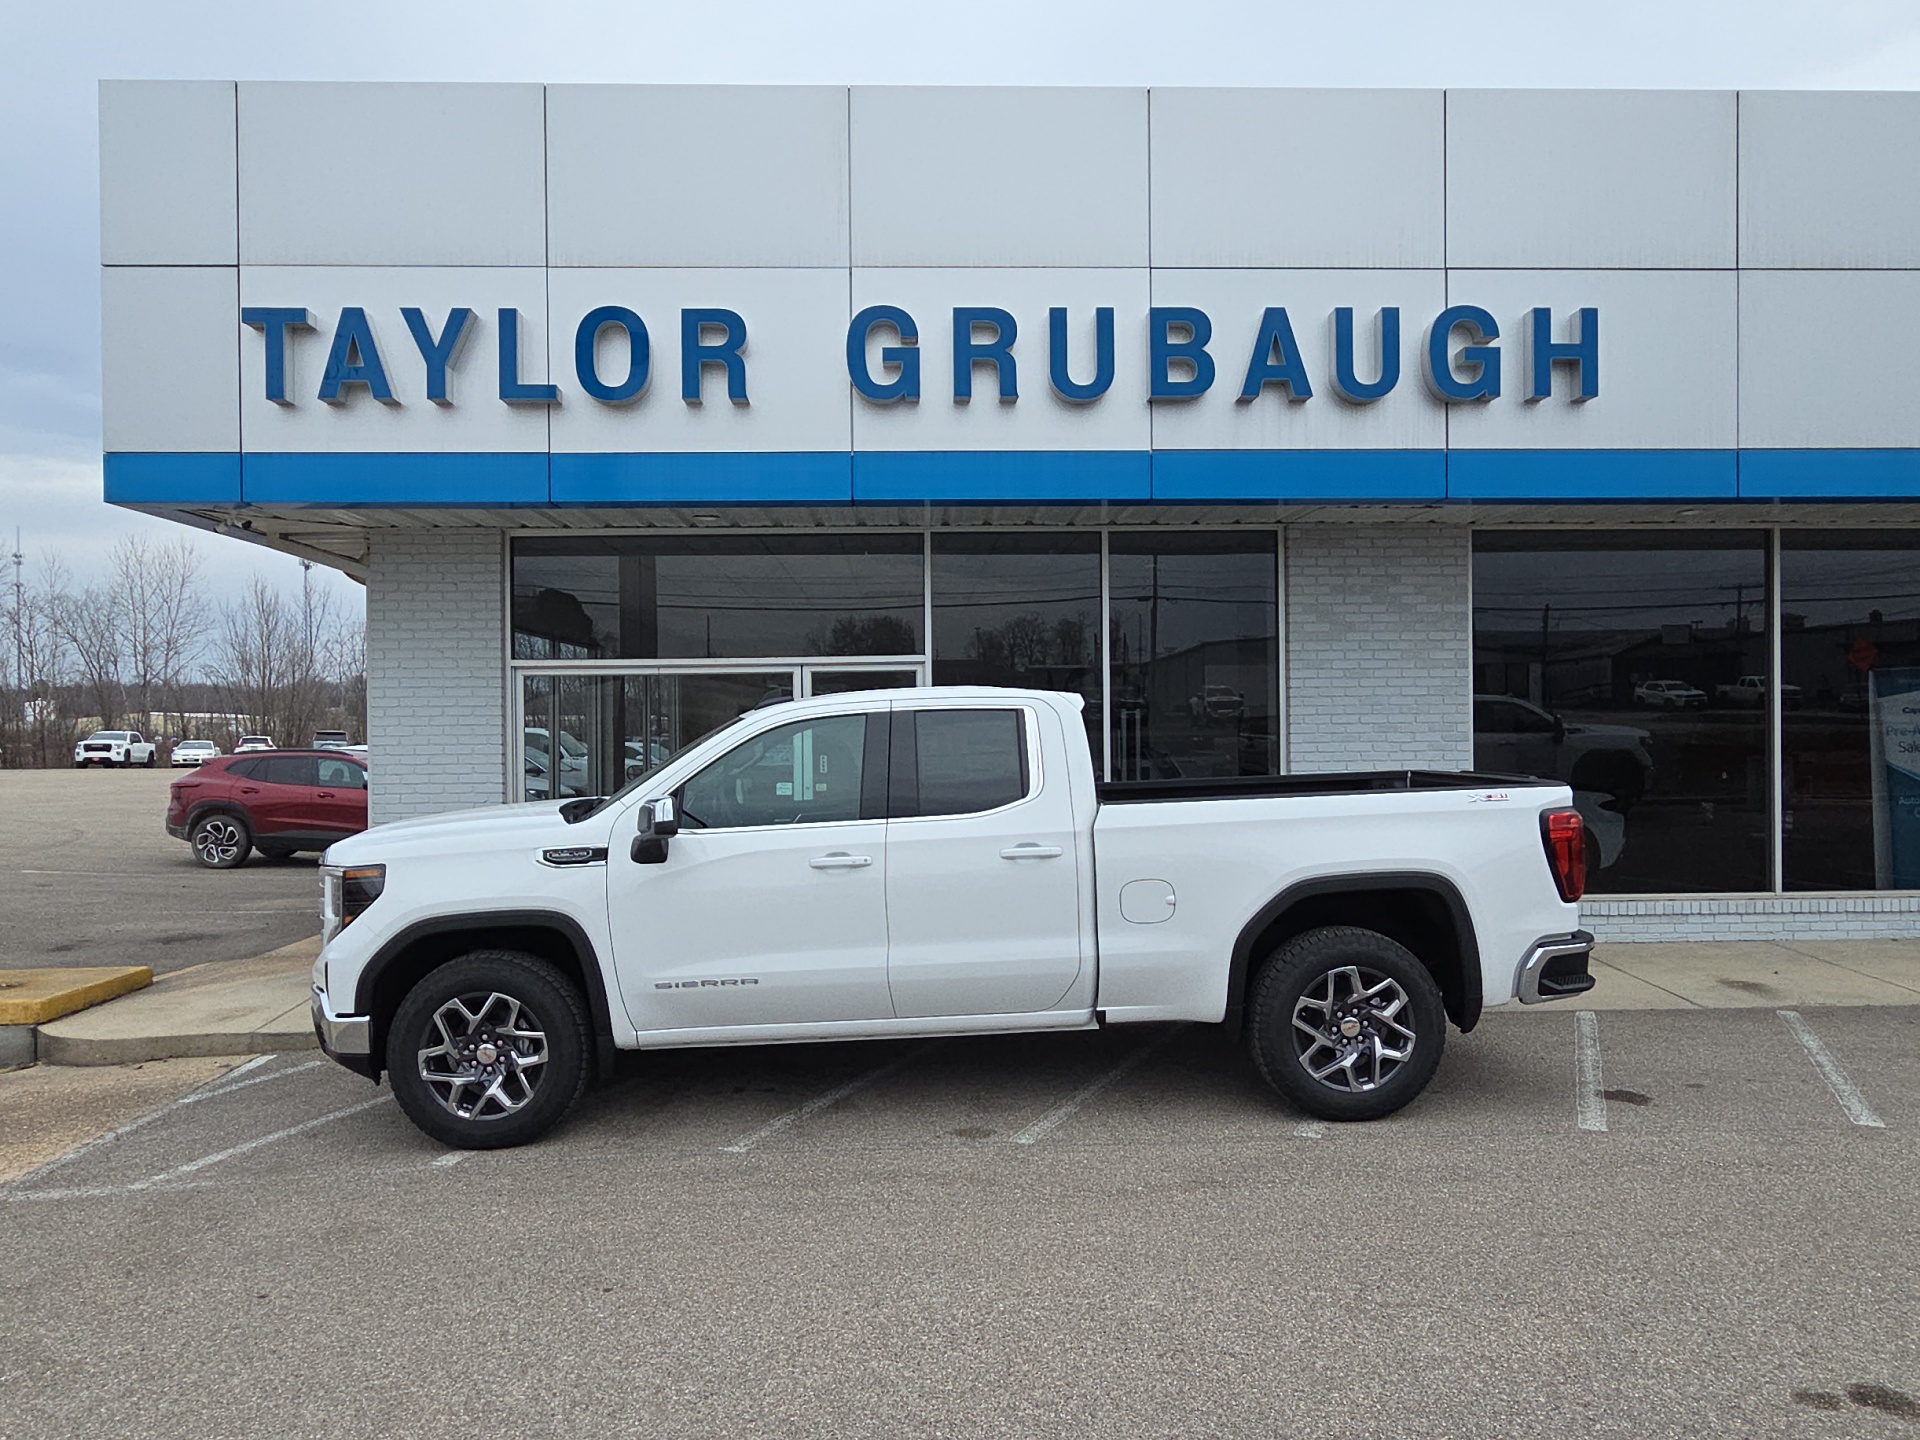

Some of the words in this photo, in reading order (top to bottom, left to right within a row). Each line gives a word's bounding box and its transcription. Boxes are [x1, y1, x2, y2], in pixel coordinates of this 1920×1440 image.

[241, 305, 749, 405] TAYLOR
[846, 304, 1600, 404] GRUBAUGH
[654, 977, 760, 990] SIERRA
